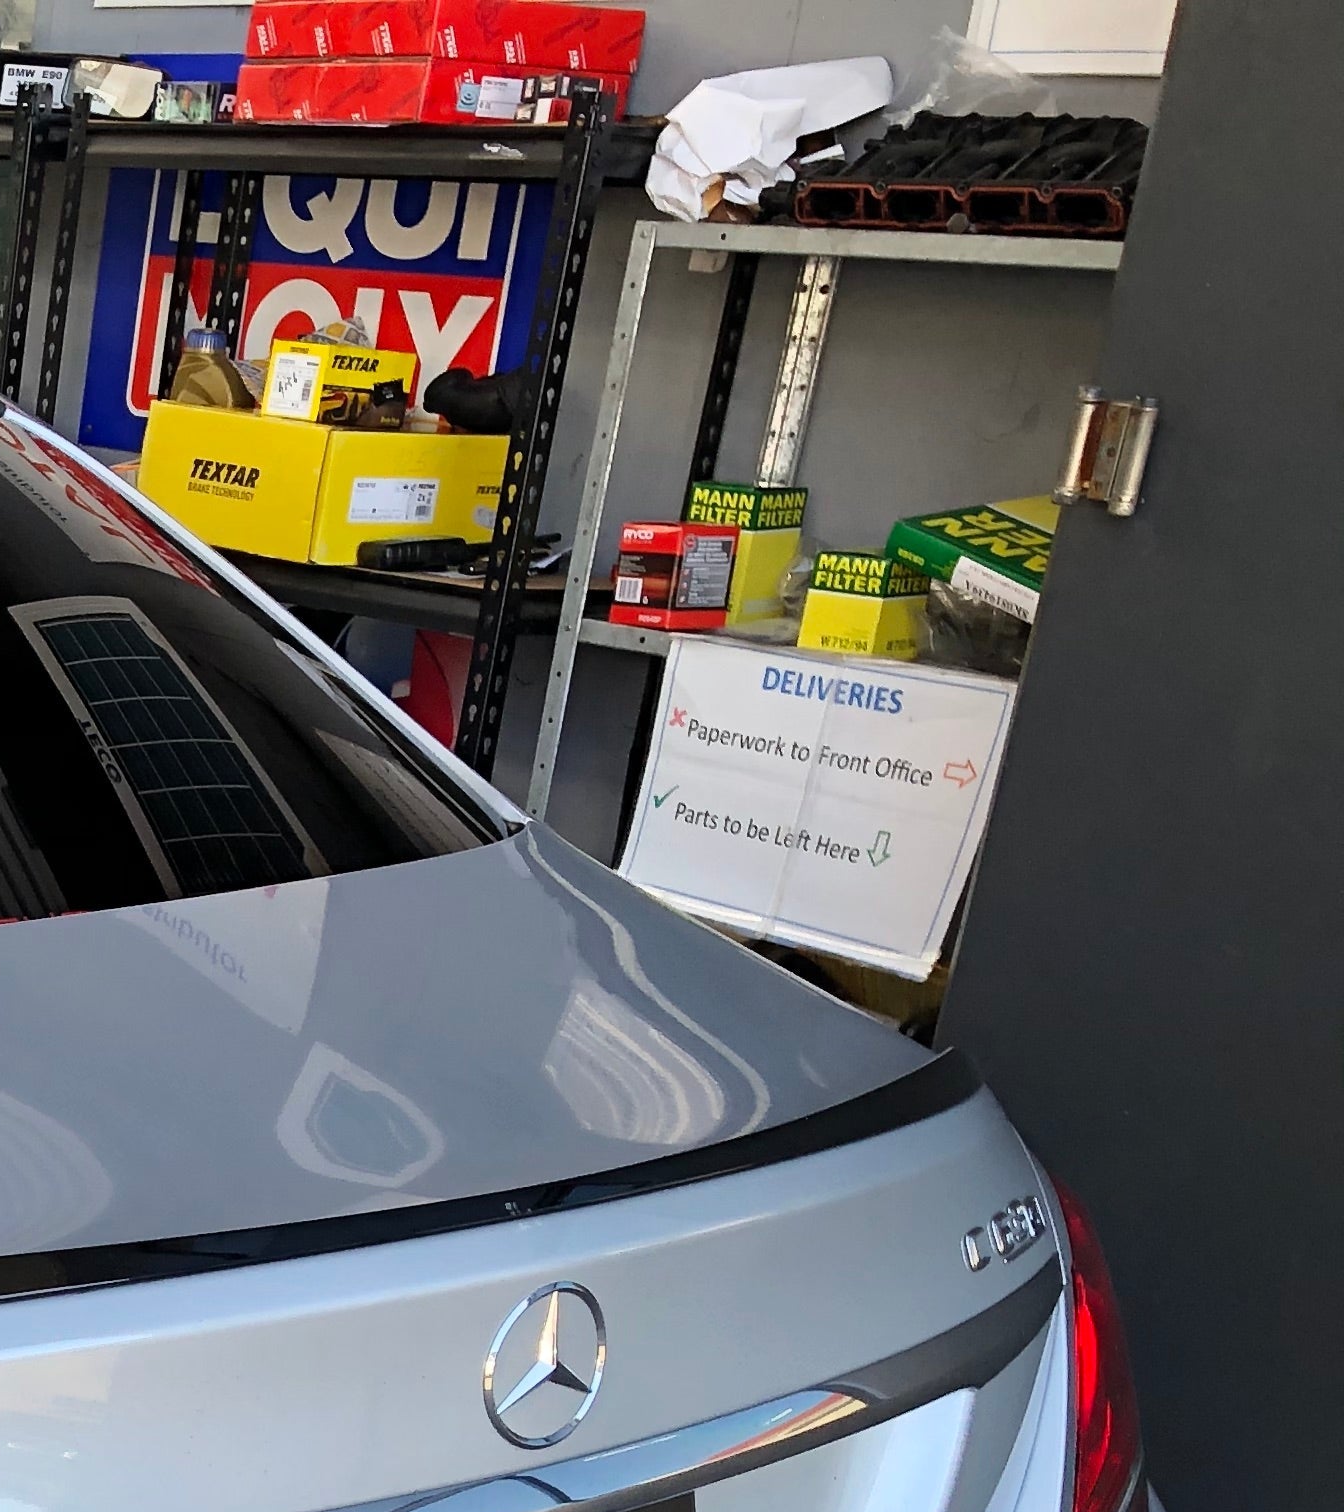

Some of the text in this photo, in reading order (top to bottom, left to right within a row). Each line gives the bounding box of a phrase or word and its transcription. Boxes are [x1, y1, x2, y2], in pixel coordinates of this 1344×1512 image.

[7, 68, 63, 80] BMW E90
[332, 354, 380, 373] TEXTAR
[190, 458, 260, 489] TEXTAR
[188, 482, 255, 502] BRAKE TECHNOLOGY
[477, 485, 501, 495] TEXTA
[692, 487, 756, 510] MANN
[761, 492, 806, 511] MANN
[690, 505, 752, 528] FILTER
[757, 509, 802, 527] FILTER
[623, 528, 654, 540] RYCO
[818, 553, 887, 577] MANN
[814, 571, 882, 594] FILTER
[887, 577, 930, 594] FILTER
[762, 666, 904, 715] DELIVERIES
[687, 718, 934, 788] Paperwork to Front Office
[673, 801, 861, 864] Parts to be Left Here
